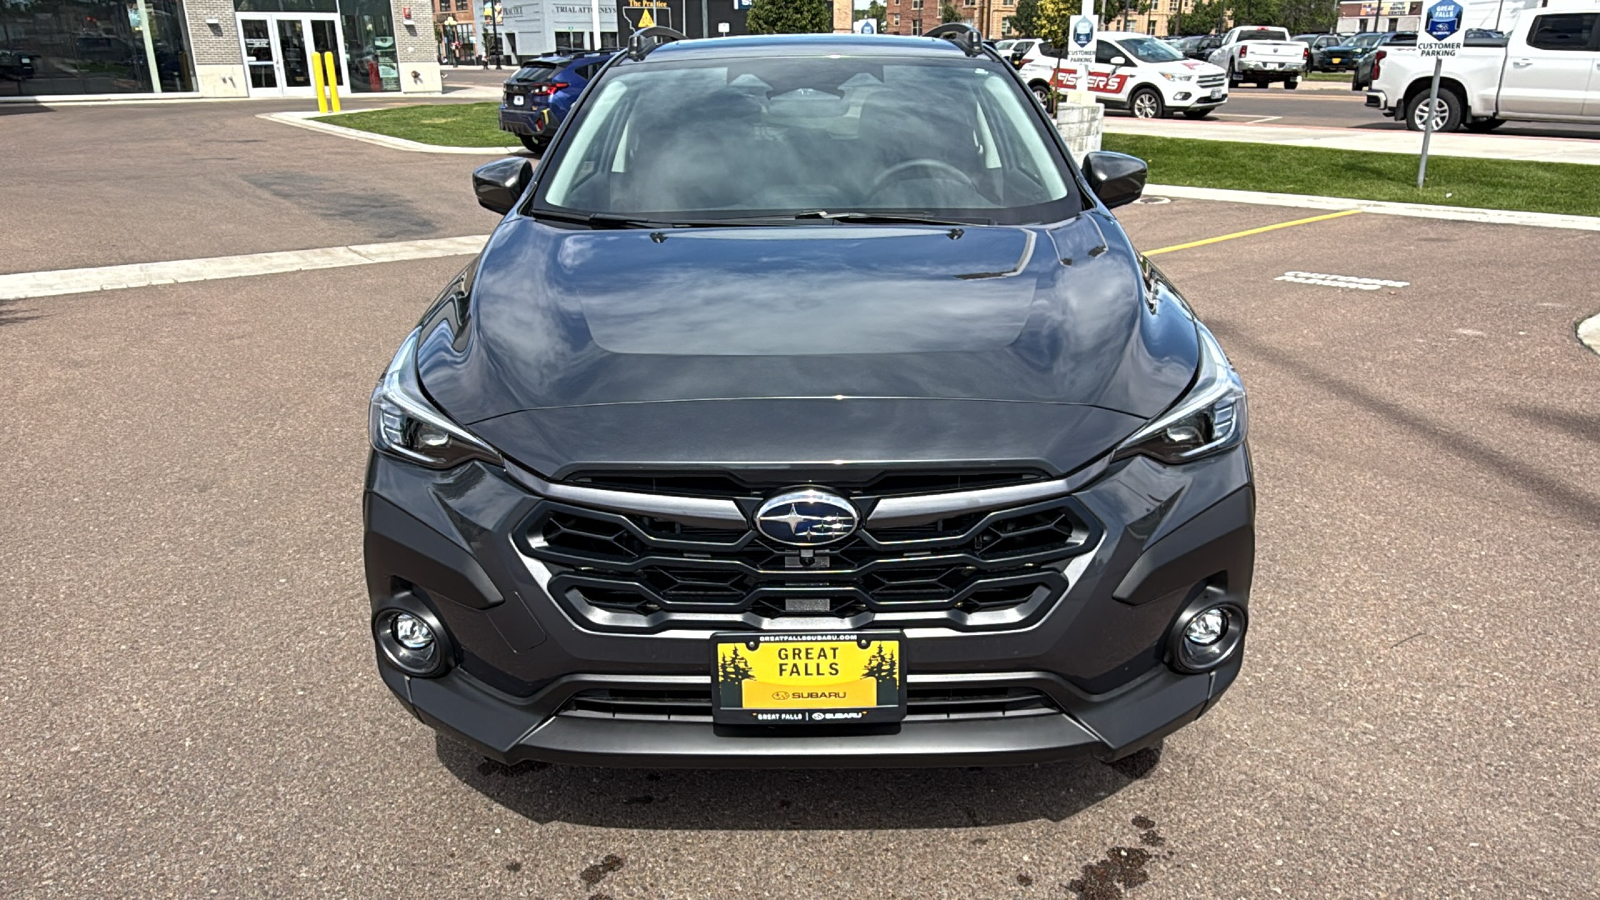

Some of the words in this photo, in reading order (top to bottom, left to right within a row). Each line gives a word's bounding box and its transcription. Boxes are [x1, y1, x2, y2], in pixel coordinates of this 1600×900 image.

[759, 634, 858, 642] GREATFALLSSUBARU.COM
[778, 647, 839, 661] GREAT
[779, 662, 839, 676] FALLS
[792, 691, 847, 699] SUBARU
